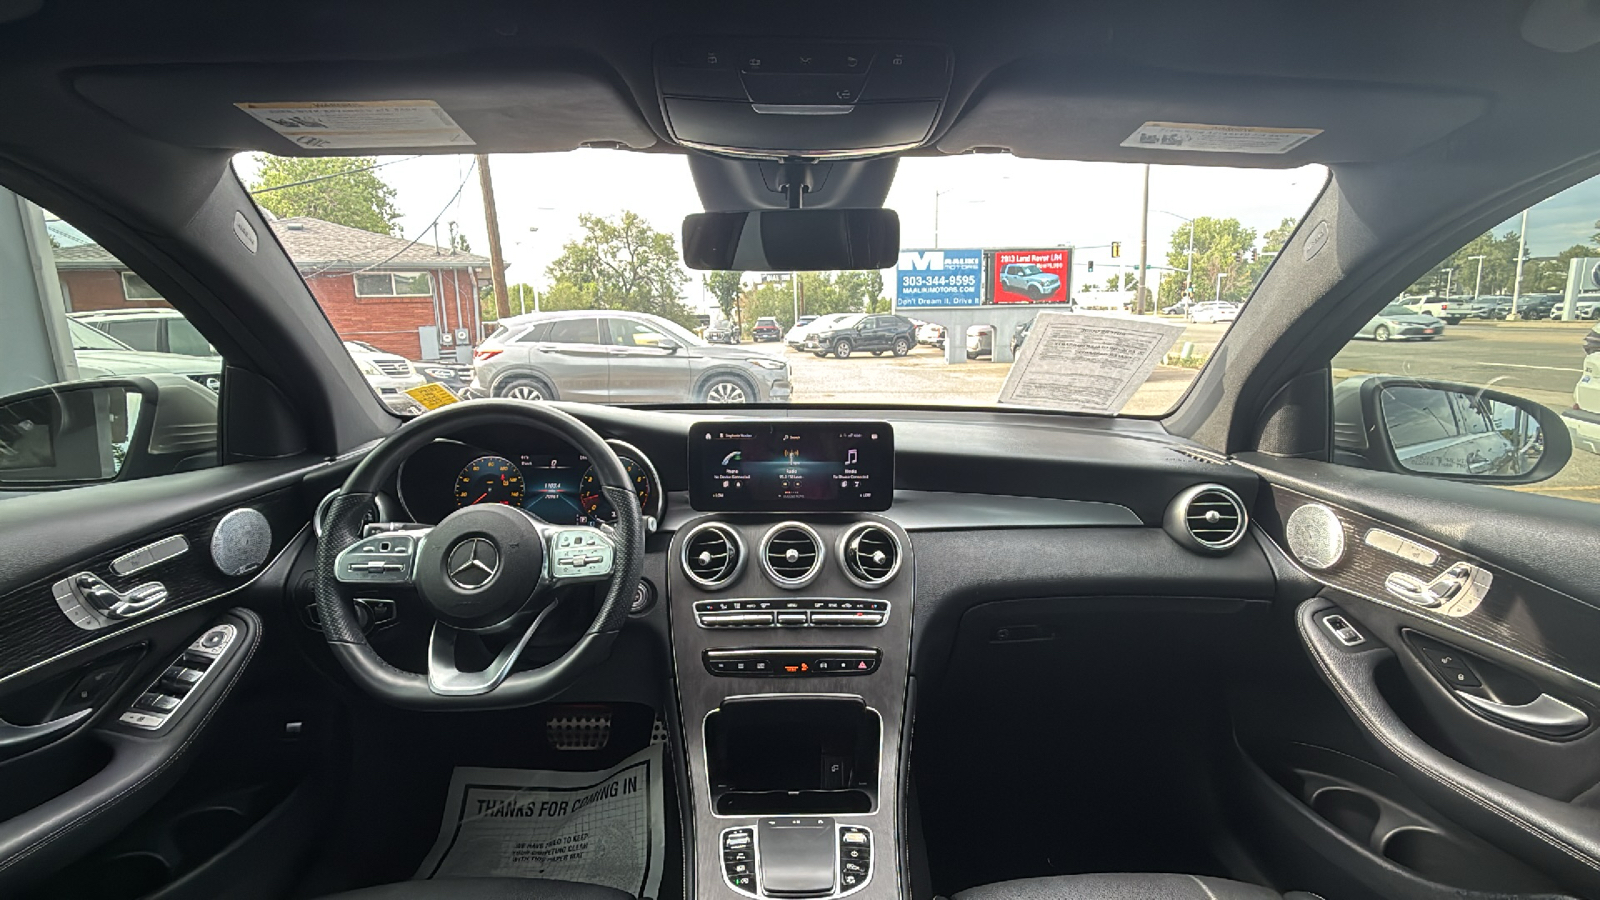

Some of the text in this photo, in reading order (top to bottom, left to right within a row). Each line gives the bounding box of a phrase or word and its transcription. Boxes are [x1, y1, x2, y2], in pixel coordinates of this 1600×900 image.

[1032, 254, 1050, 262] Rover
[902, 275, 976, 286] 303-344-9595
[476, 776, 637, 818] THANKS FOR COMING IN
[563, 836, 572, 844] TO
[573, 833, 589, 842] KEEP
[568, 842, 589, 852] CLEAN
